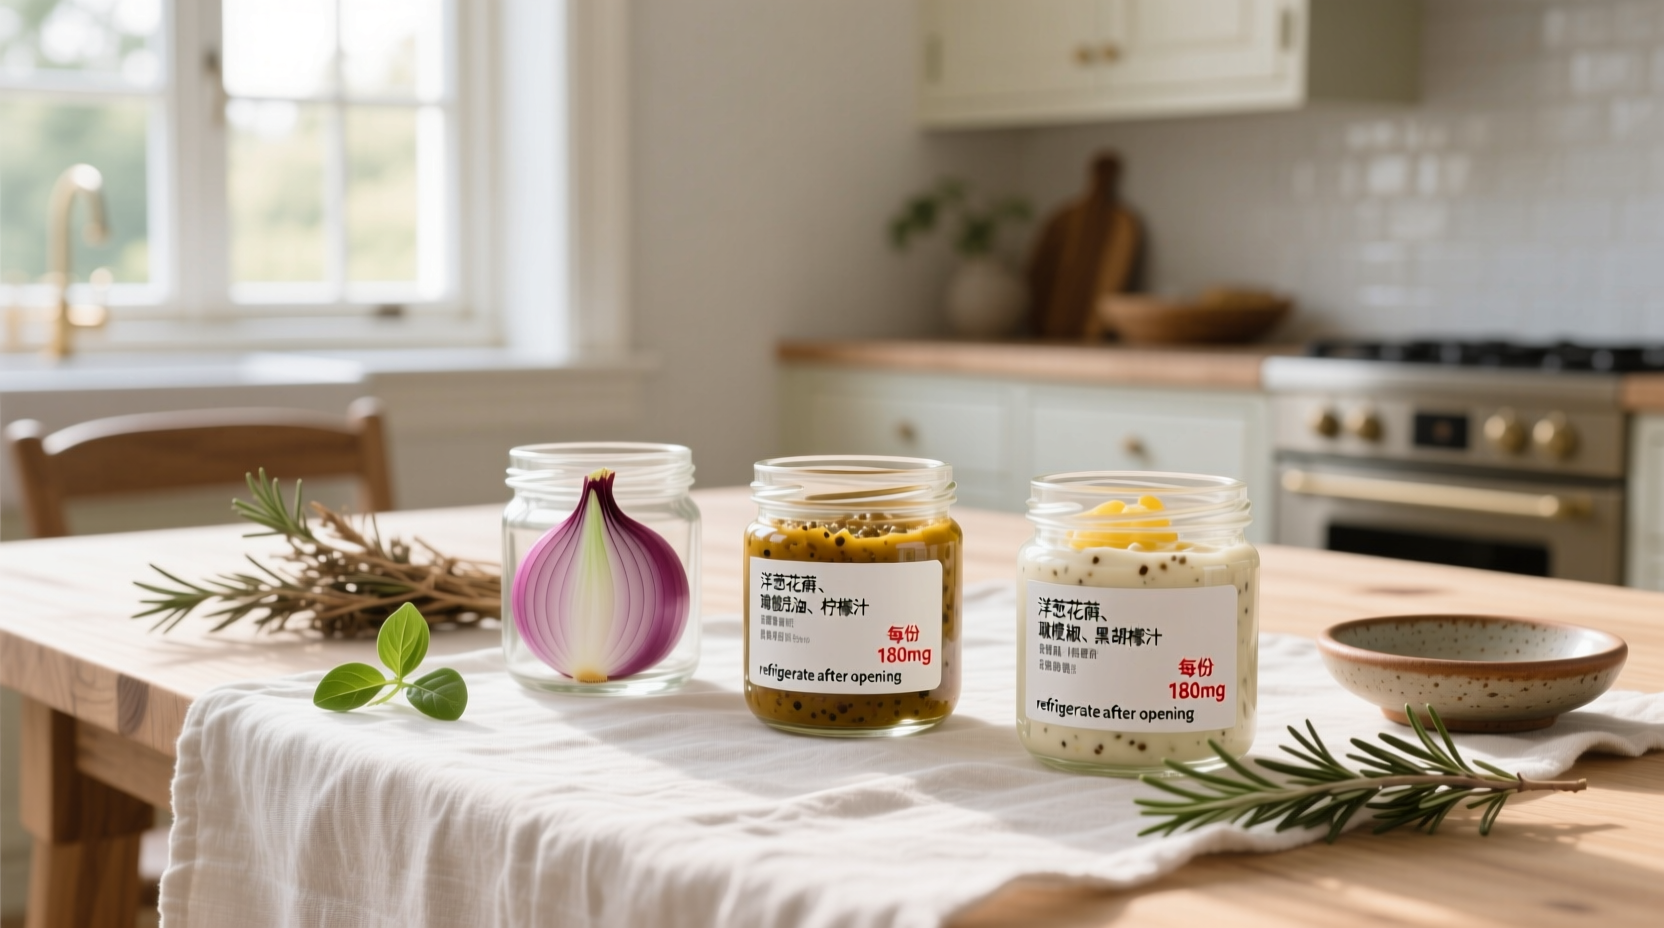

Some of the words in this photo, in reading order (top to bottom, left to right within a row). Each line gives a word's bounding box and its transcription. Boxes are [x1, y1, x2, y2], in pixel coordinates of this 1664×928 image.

[887, 625, 919, 644] 每份
[878, 647, 931, 665] 180mg
[818, 669, 848, 682] after
[851, 670, 902, 685] opening
[1178, 657, 1213, 678] 每份
[1169, 682, 1225, 702] 180mg
[1037, 698, 1100, 718] refrigerate
[1103, 705, 1136, 719] after
[1140, 707, 1194, 723] opening
